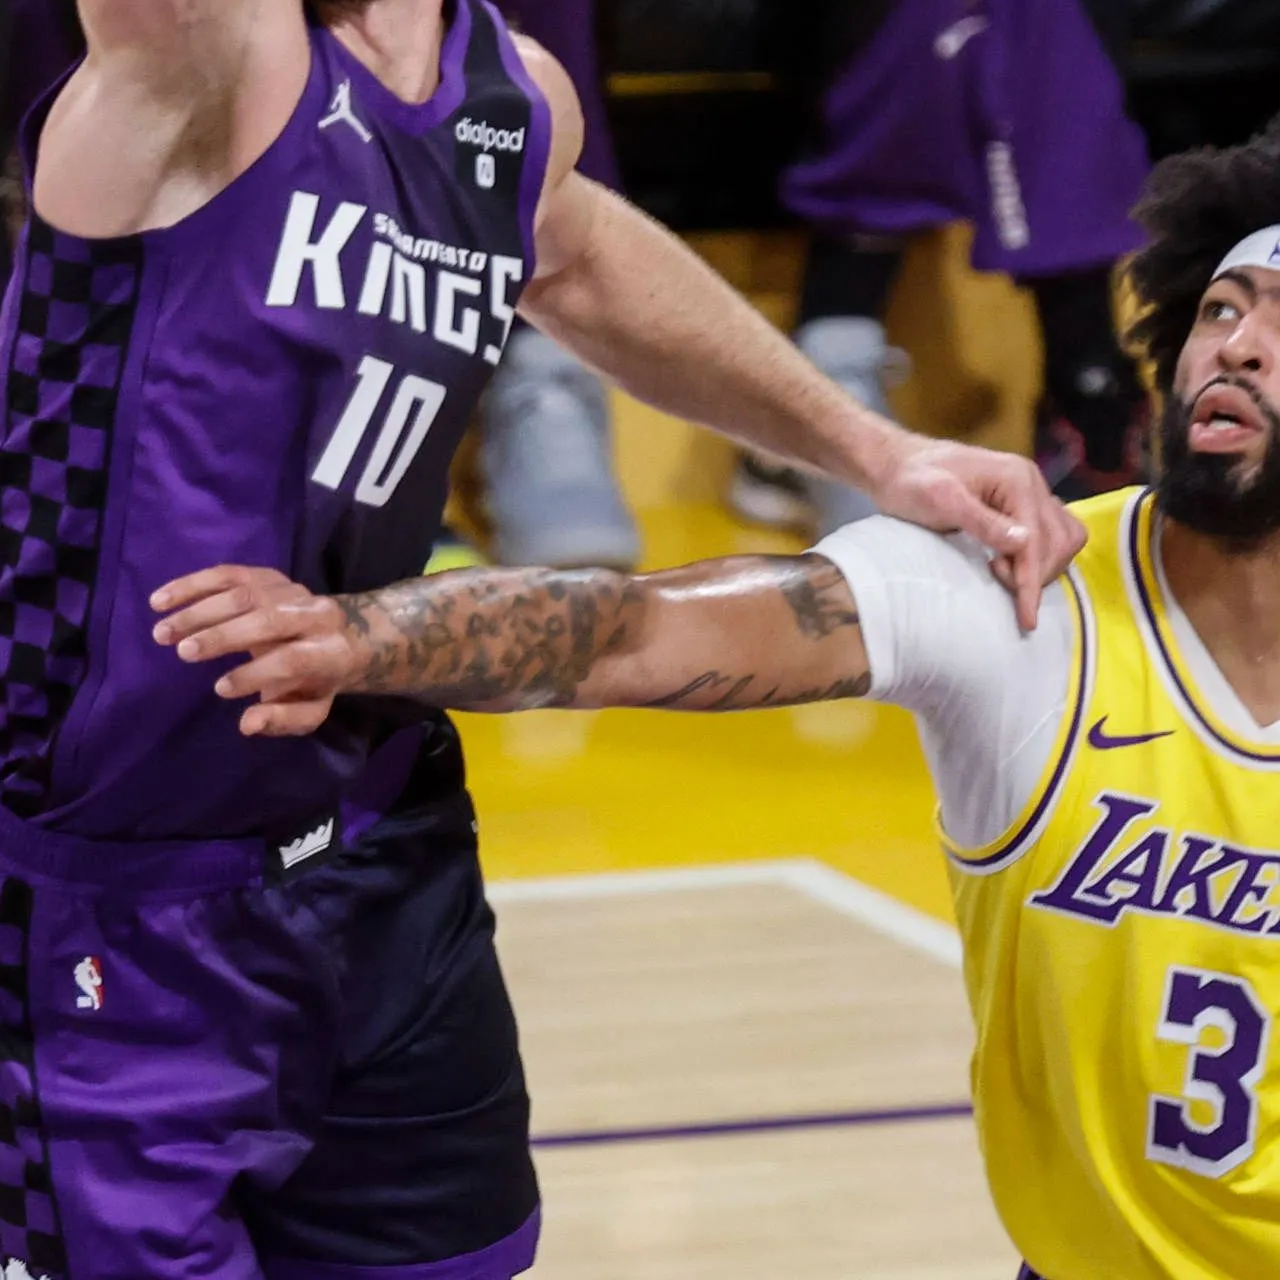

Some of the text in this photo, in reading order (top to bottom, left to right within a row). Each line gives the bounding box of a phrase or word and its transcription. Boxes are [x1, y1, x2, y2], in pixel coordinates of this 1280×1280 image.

[455, 117, 526, 152] dialpad
[311, 354, 448, 508] 10
[1146, 965, 1271, 1179] 3
